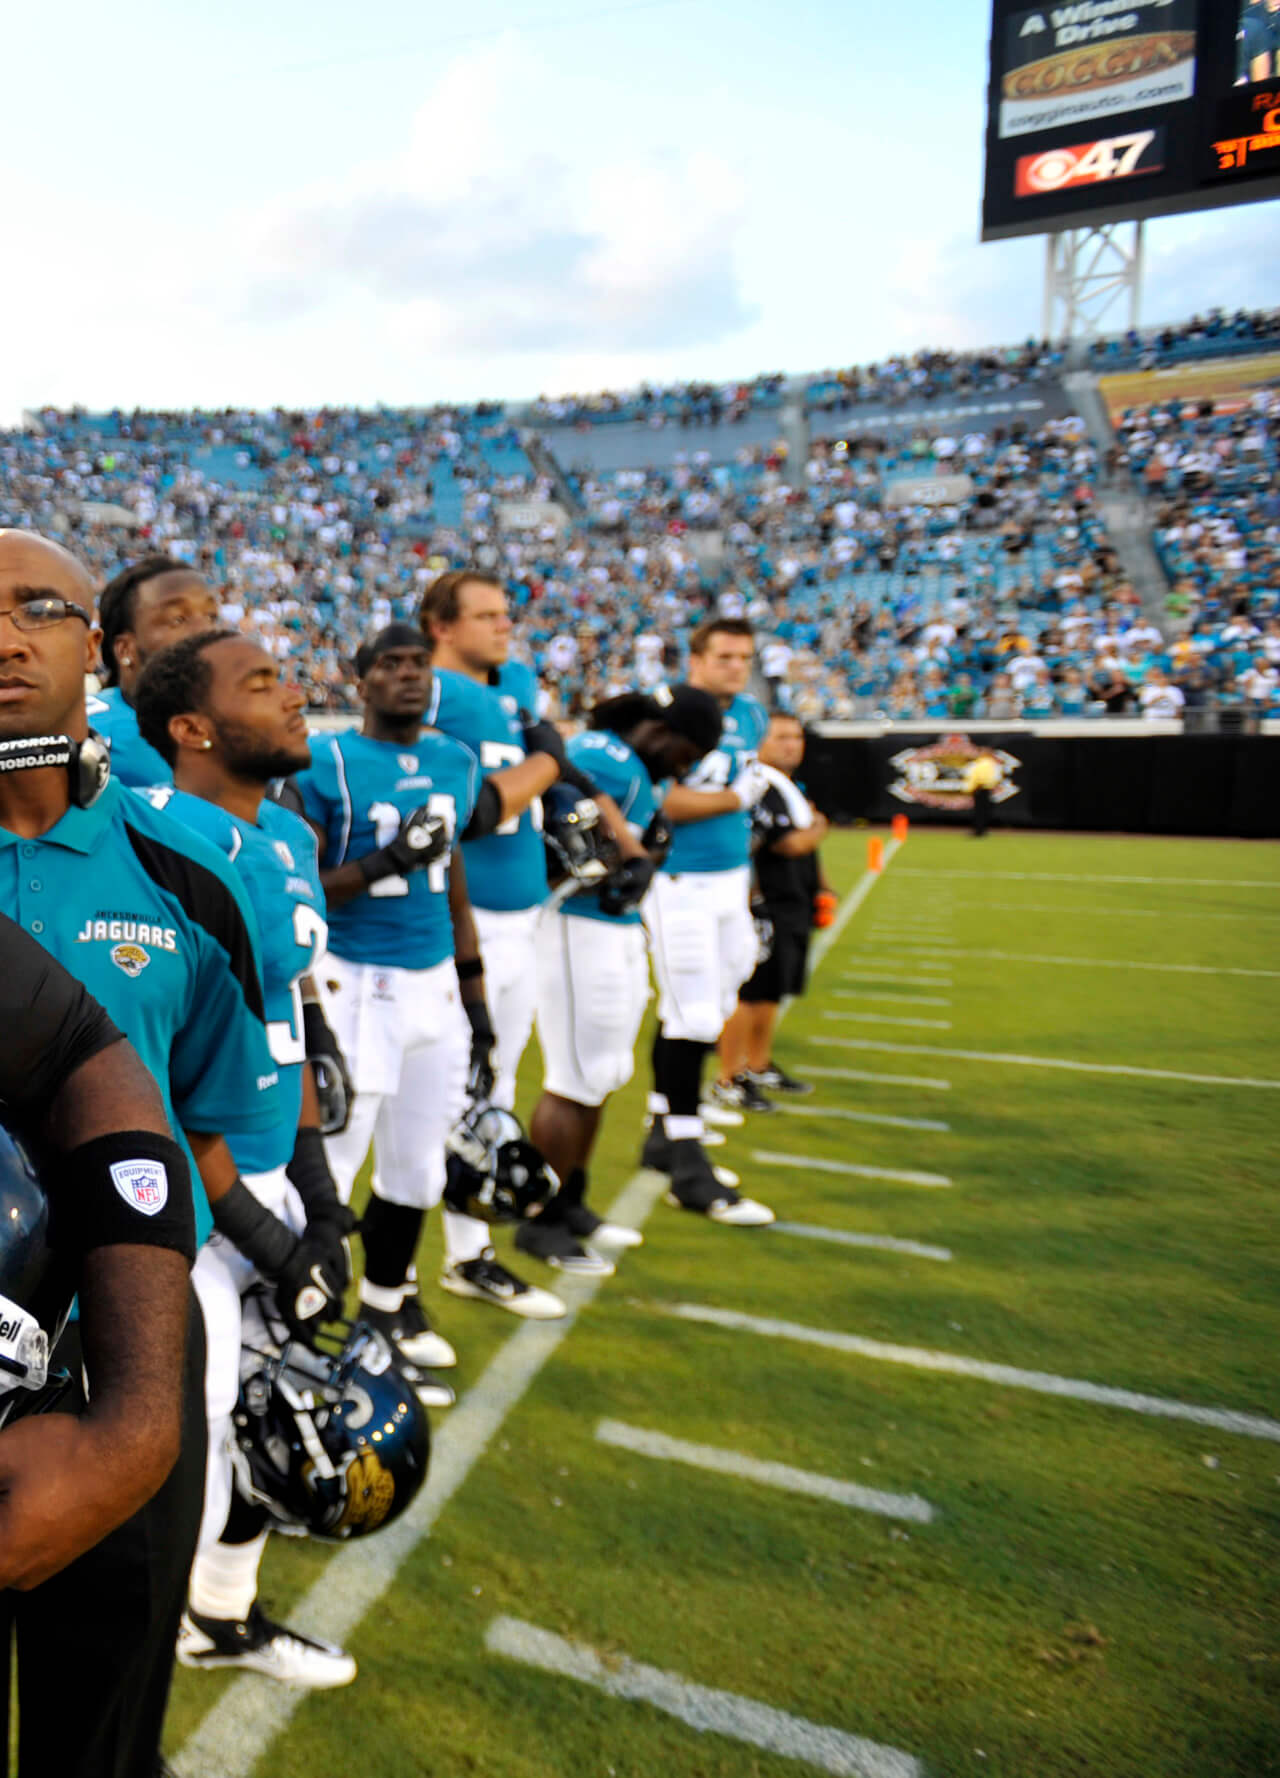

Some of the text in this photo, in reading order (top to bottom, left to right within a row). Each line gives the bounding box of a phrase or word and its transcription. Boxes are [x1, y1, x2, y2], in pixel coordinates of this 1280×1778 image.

[1073, 129, 1156, 180] 47
[74, 919, 179, 954] JAGUARS
[136, 1188, 160, 1202] NFL
